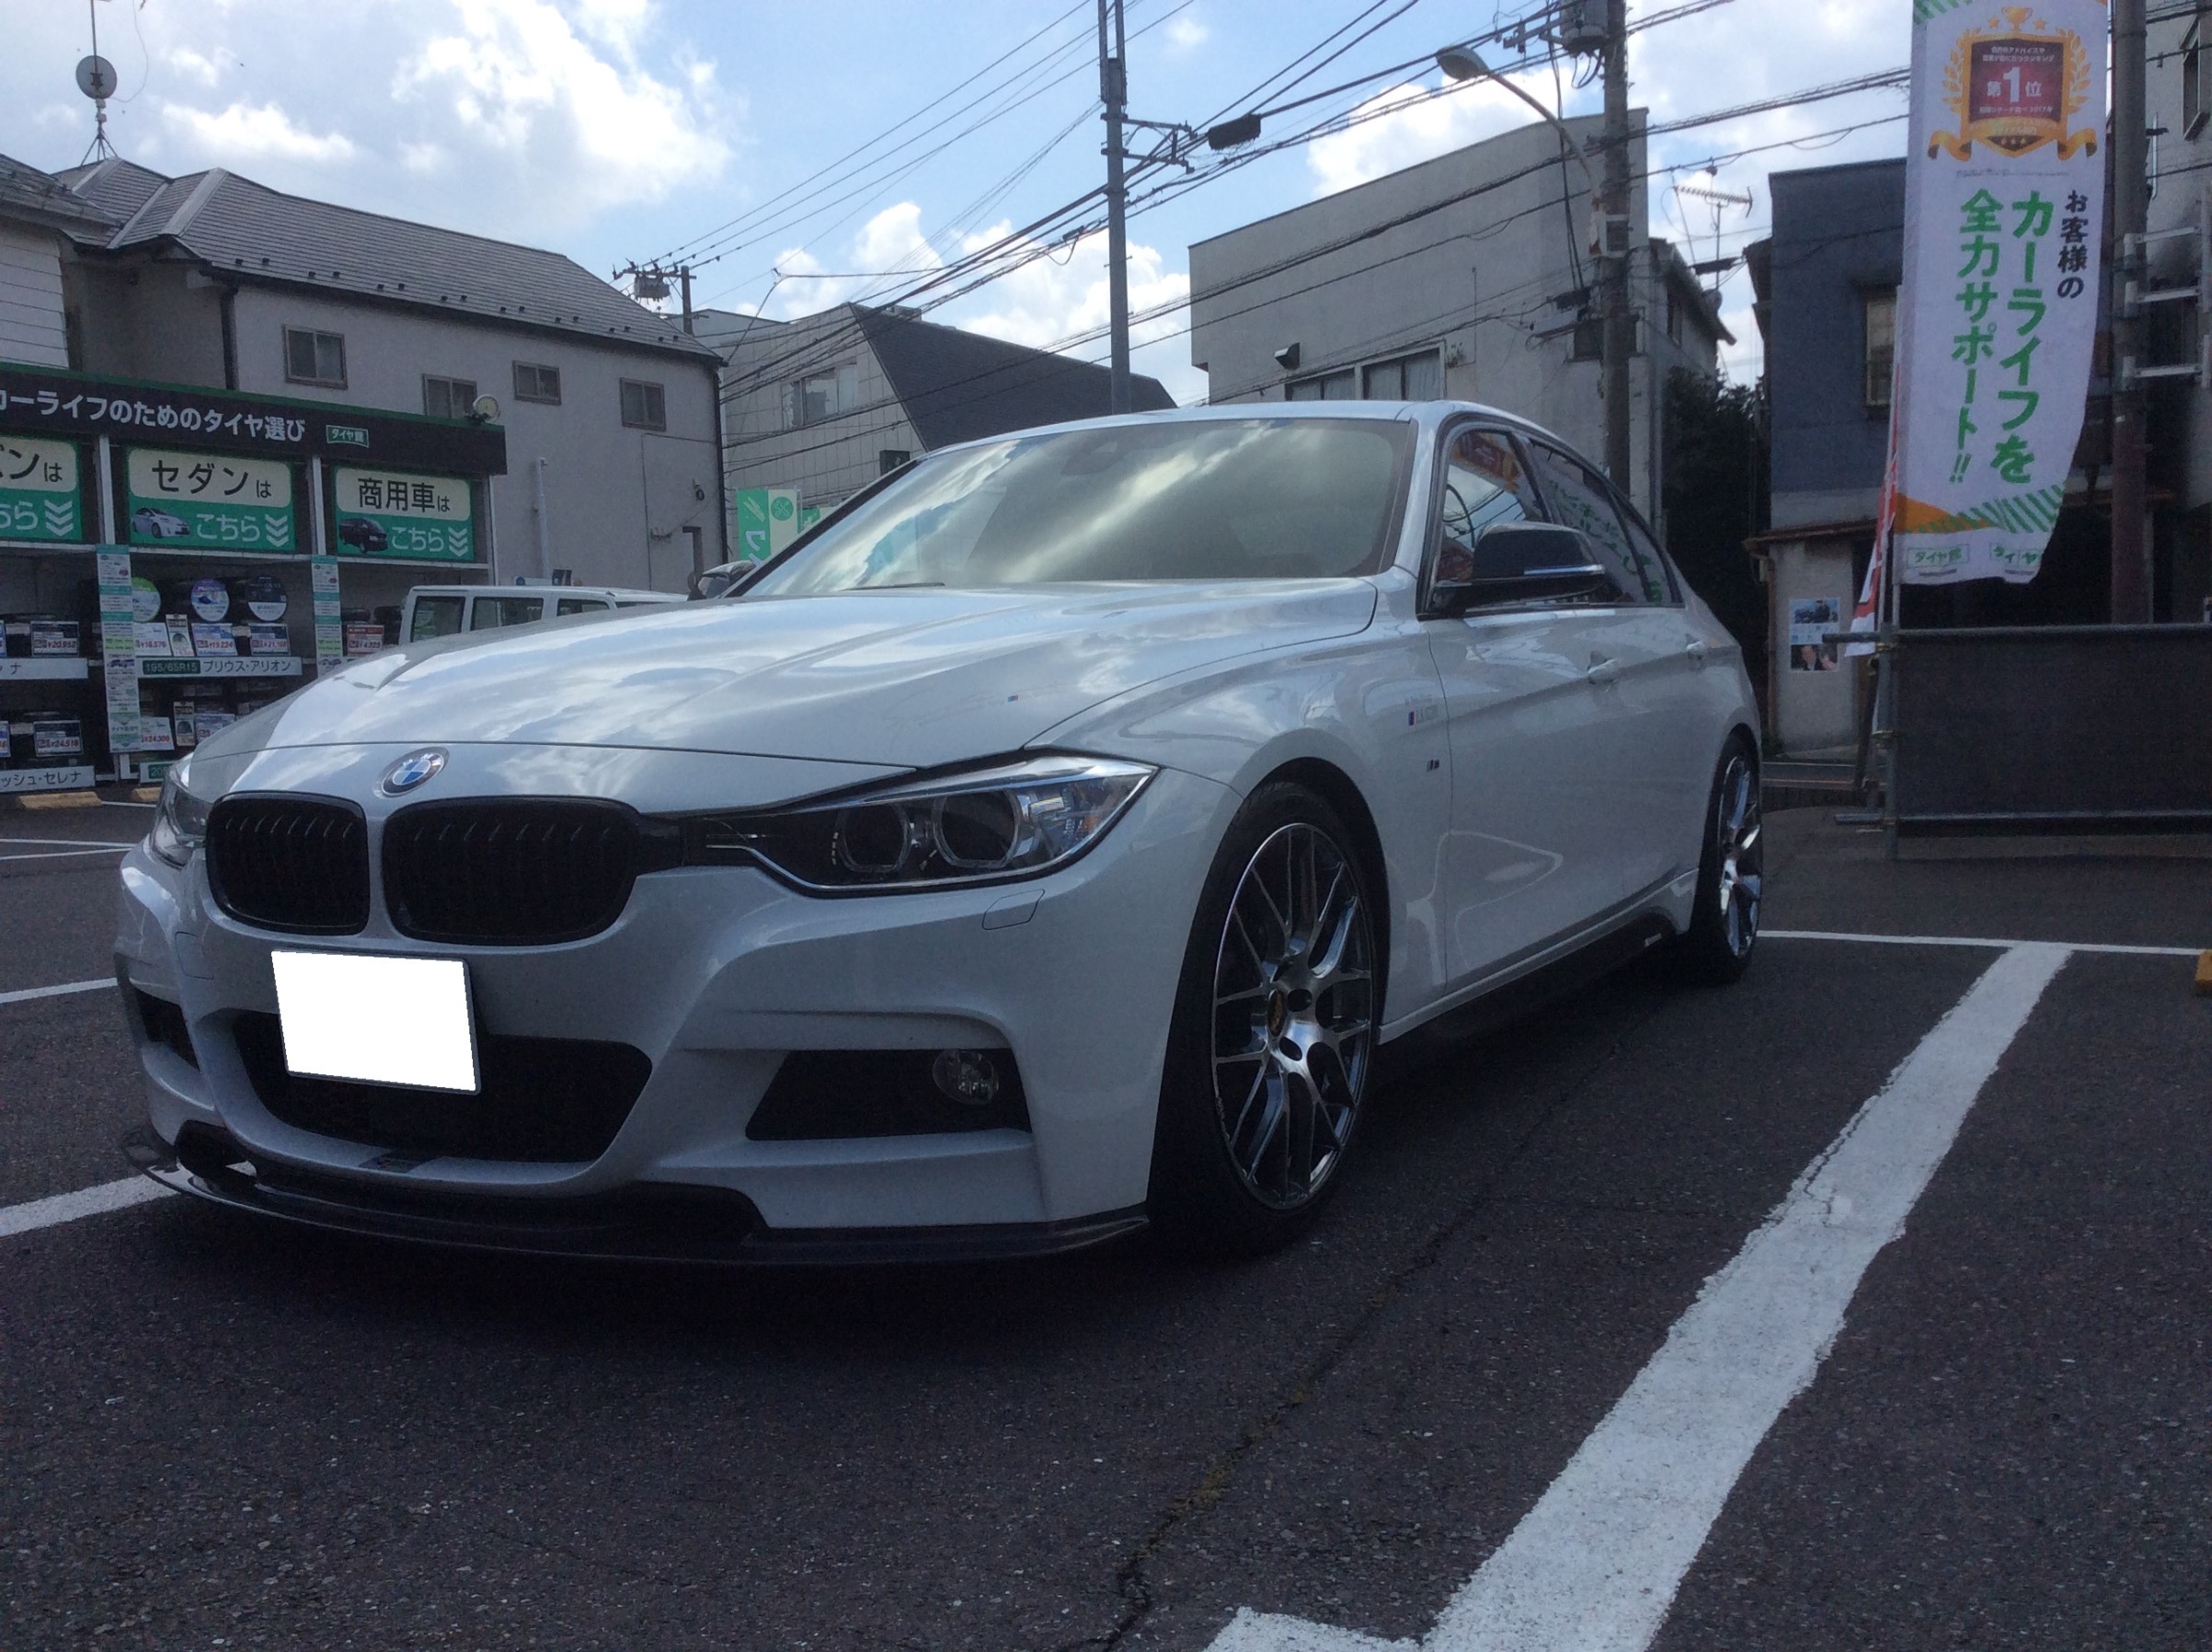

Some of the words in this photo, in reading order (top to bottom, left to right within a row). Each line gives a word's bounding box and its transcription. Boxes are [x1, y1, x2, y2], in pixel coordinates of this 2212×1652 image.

[1987, 66, 2042, 103] 第1位
[2057, 189, 2089, 299] お客様の
[1989, 189, 2055, 484] カーライフを
[0, 445, 63, 483] ンは
[152, 460, 271, 498] セダンは
[357, 476, 450, 512] 商用車は
[196, 512, 261, 542] こちら
[391, 524, 445, 551] こちら
[146, 661, 198, 673] 195/65R15
[203, 660, 292, 673] プリウス・アリオン
